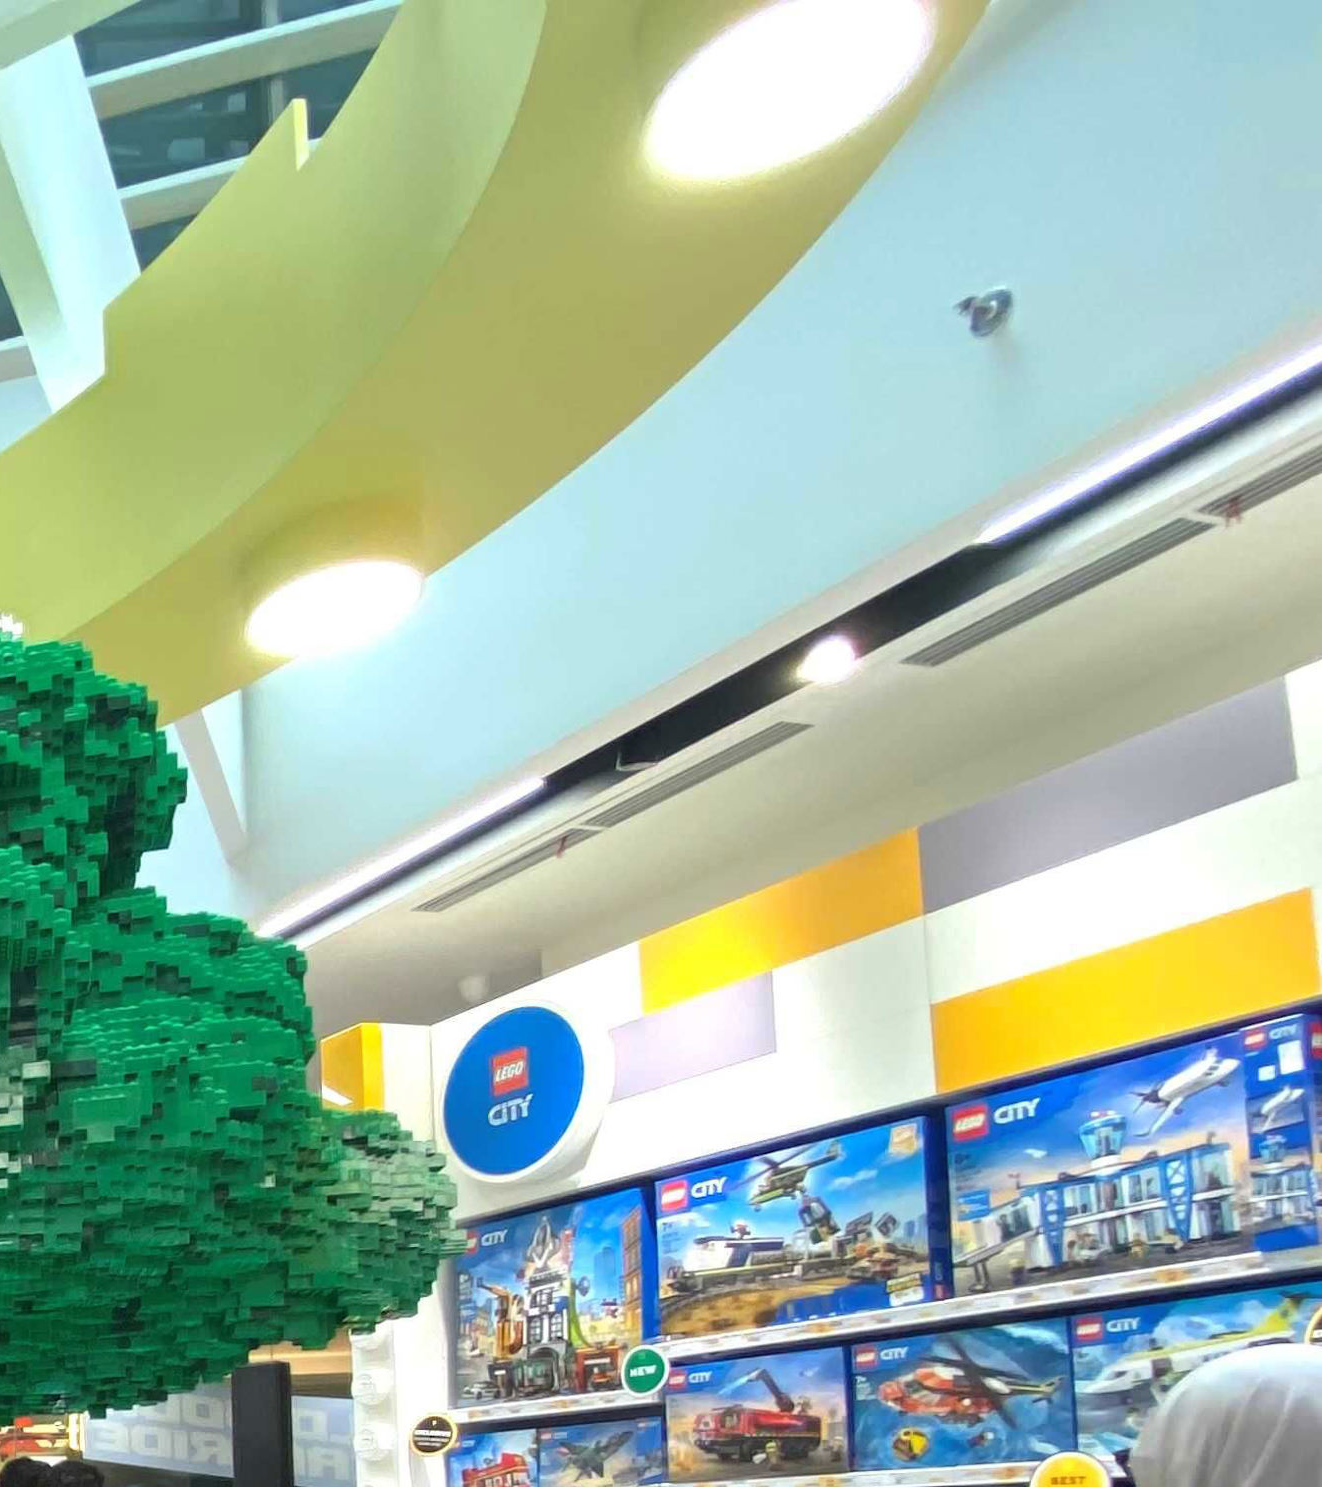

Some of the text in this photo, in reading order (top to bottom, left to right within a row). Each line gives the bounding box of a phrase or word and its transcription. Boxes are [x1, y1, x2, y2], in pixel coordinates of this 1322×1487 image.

[495, 1061, 524, 1083] LEGO
[488, 1094, 533, 1126] CITY
[994, 1098, 1040, 1124] CITY
[691, 1177, 728, 1198] CITY
[481, 1229, 507, 1246] CITY
[1107, 1317, 1141, 1332] CITY
[880, 1347, 908, 1361] CITY
[630, 1364, 657, 1378] NEW
[689, 1371, 713, 1383] CITY
[1051, 1476, 1086, 1486] BEST
